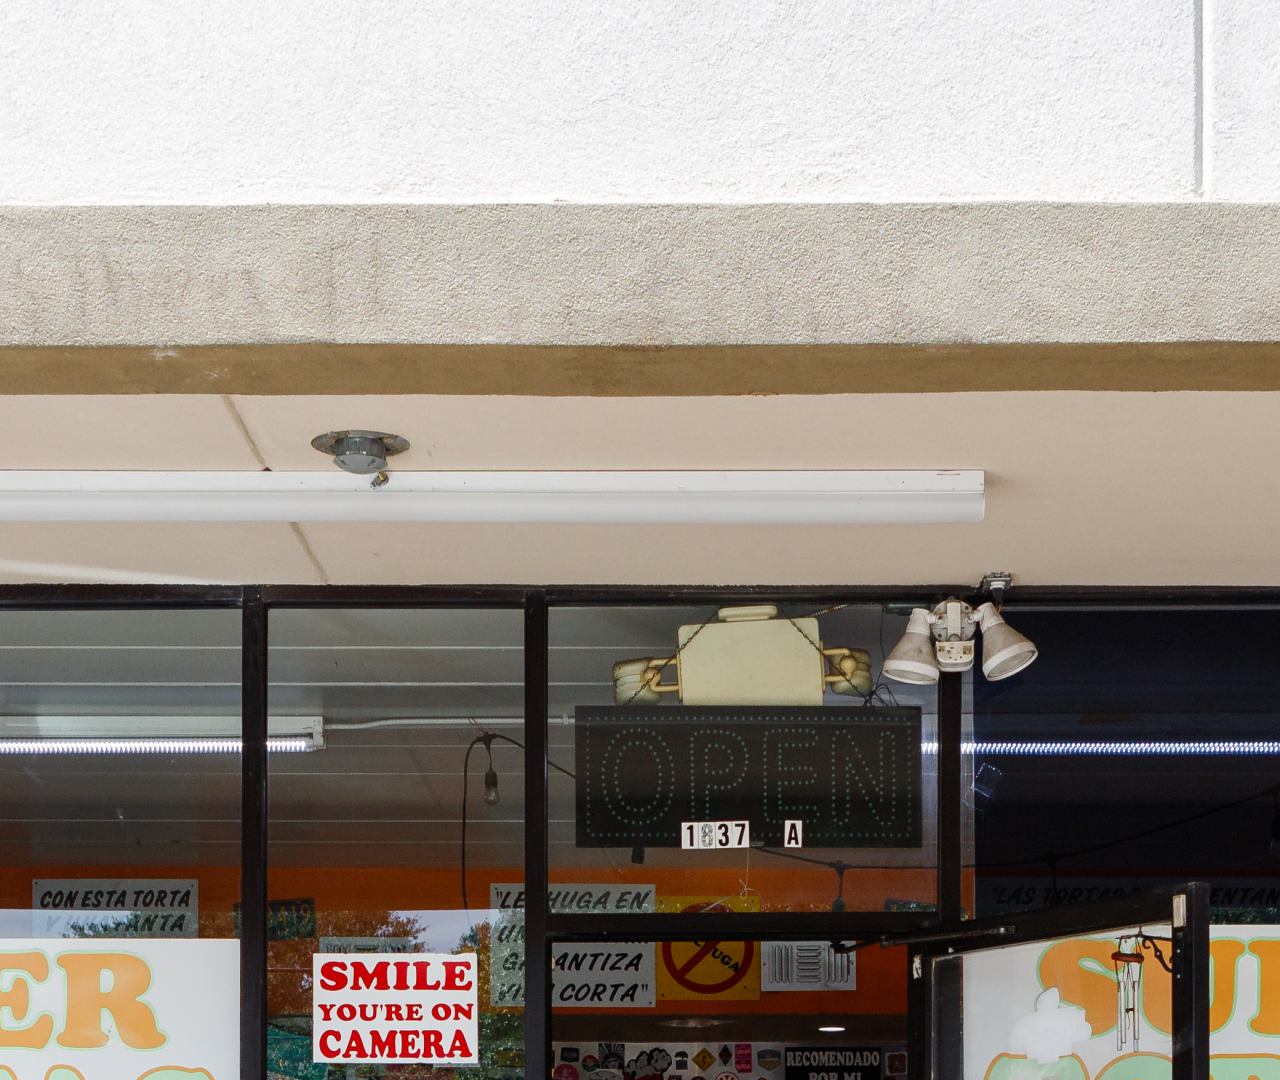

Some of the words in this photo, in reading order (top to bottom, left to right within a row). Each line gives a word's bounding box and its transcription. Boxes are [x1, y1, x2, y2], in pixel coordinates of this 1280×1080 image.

[602, 728, 897, 826] OPEN
[685, 823, 748, 847] 1837
[786, 822, 800, 846] A
[40, 890, 79, 908] CON
[81, 890, 127, 908] ESTA
[133, 889, 191, 908] TORTA
[614, 889, 649, 909] EN
[319, 961, 473, 991] SMILE
[318, 1003, 423, 1022] YOU'RE
[431, 1003, 473, 1021] ON
[319, 1029, 473, 1059] CAMERA
[785, 1051, 880, 1067] RECOMENDADO
